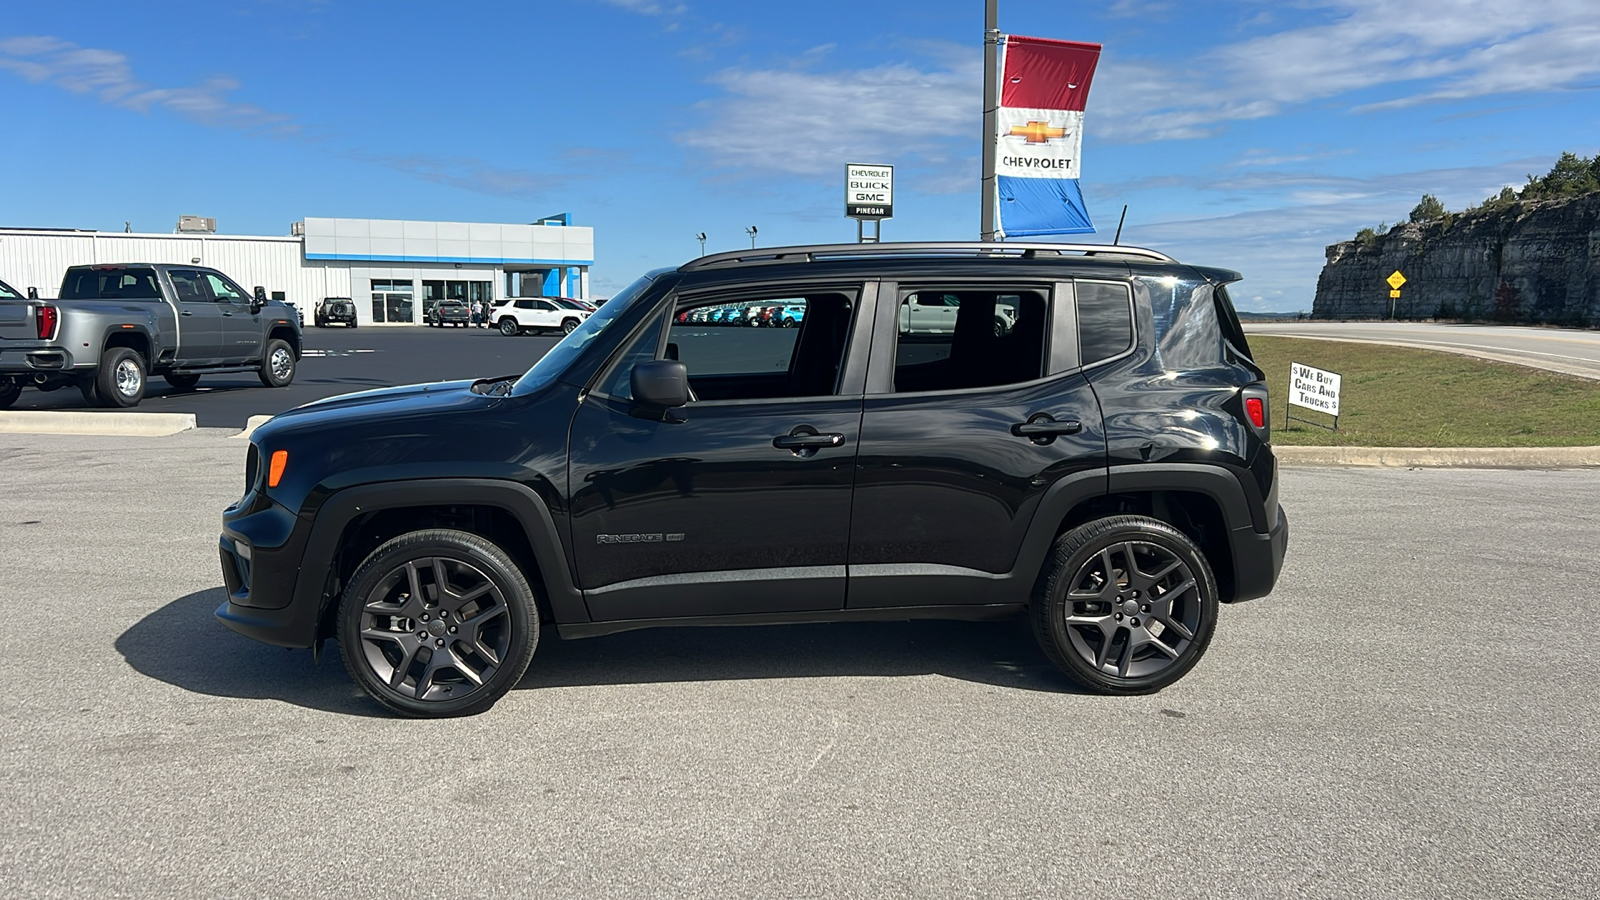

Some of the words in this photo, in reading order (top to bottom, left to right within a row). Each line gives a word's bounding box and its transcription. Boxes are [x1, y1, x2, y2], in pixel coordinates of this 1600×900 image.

[1002, 156, 1072, 169] CHEVROLET
[851, 170, 889, 178] CHEVROLET
[850, 182, 889, 190] BUICK
[596, 534, 663, 544] RENEGADE
